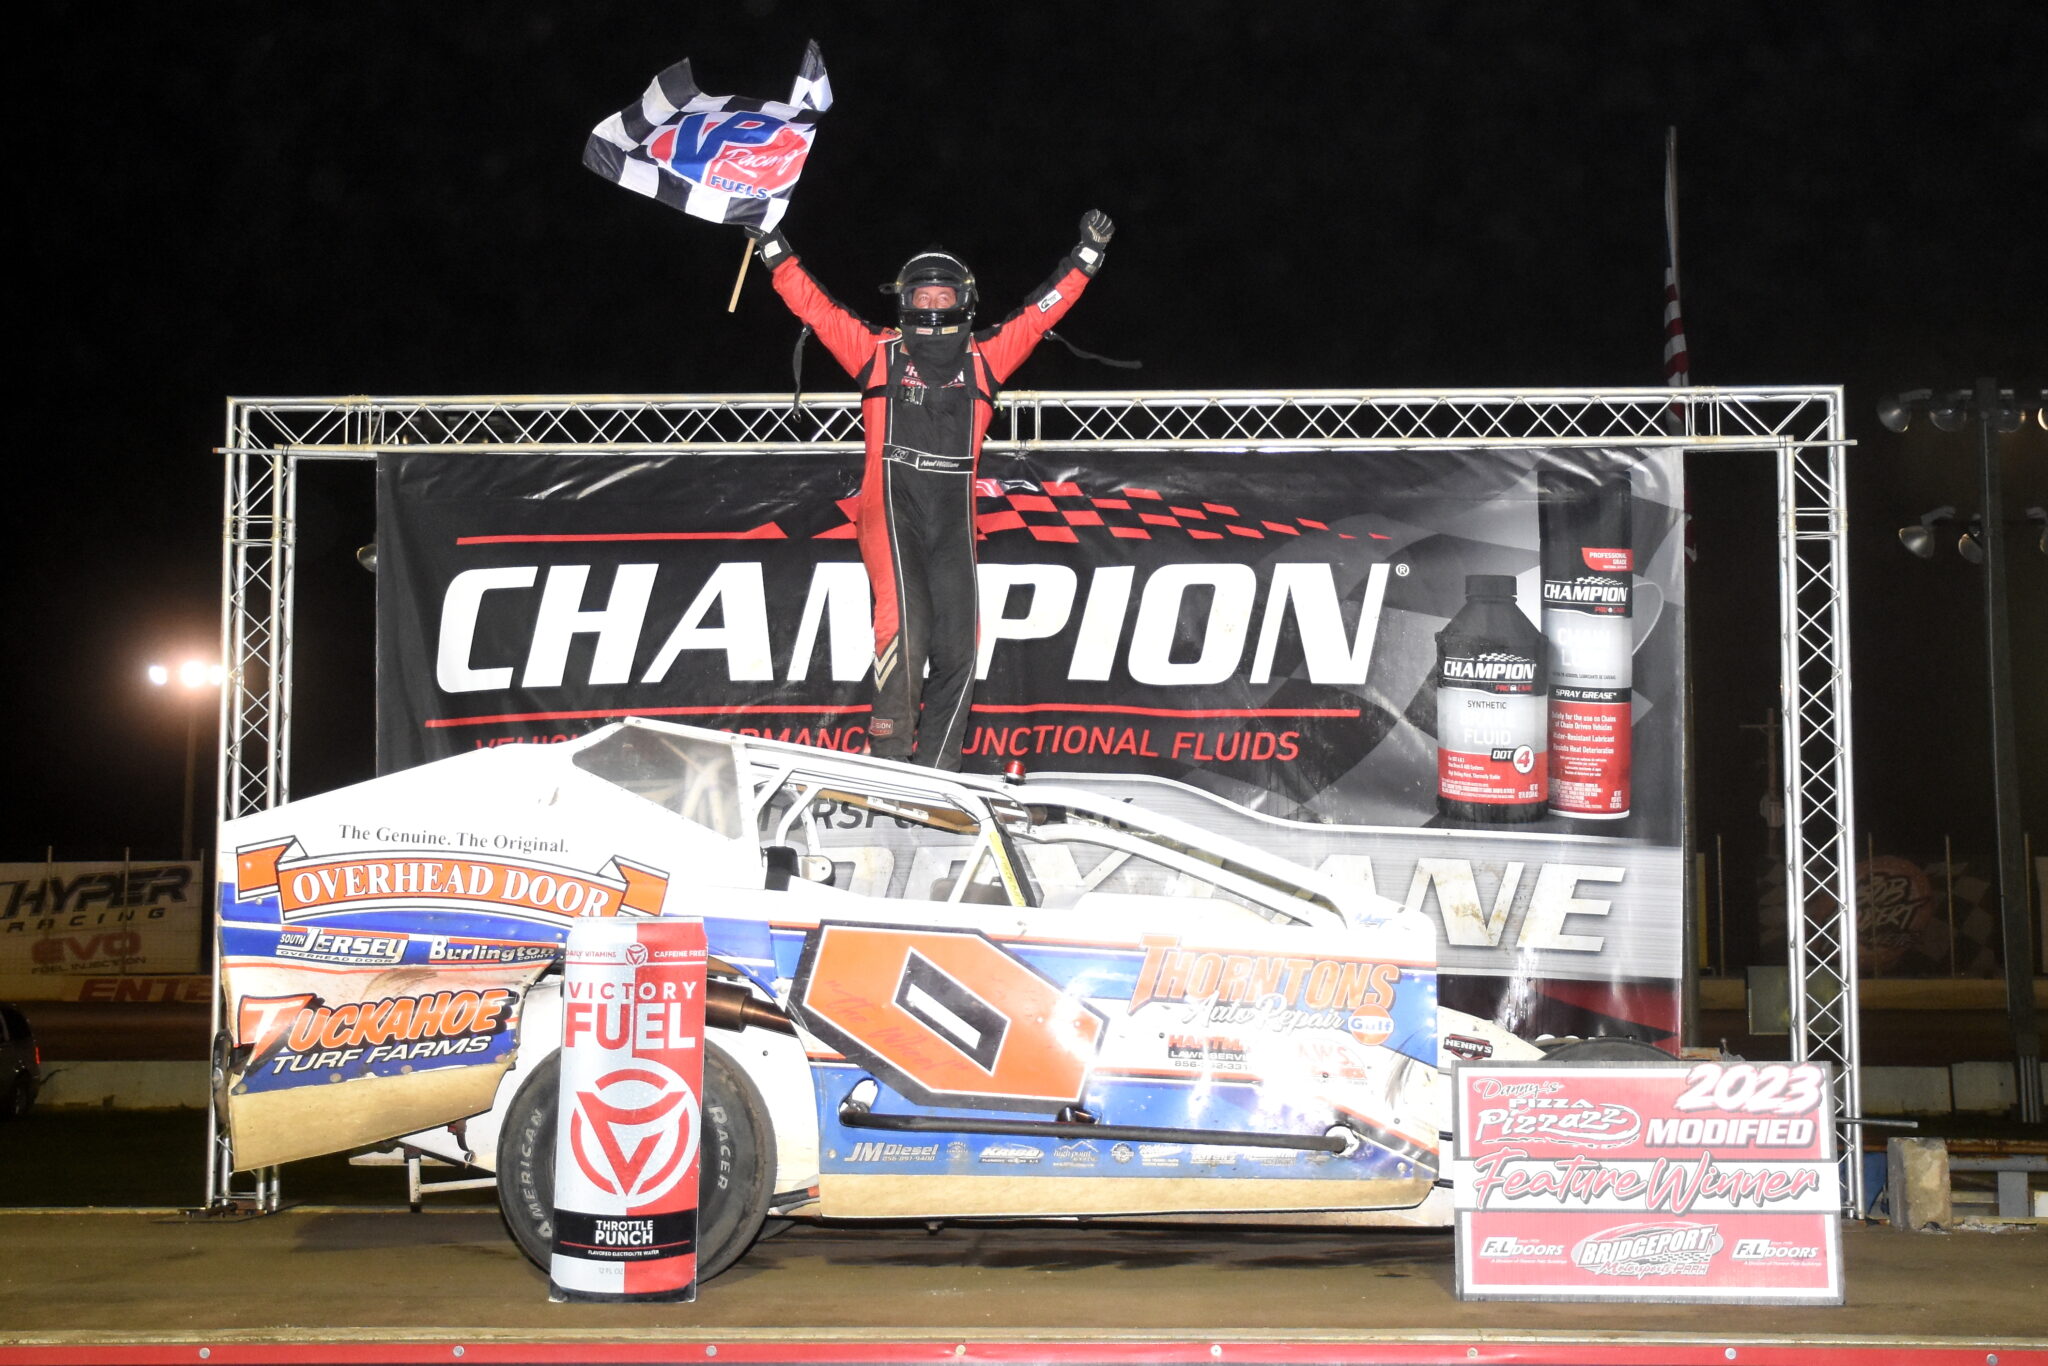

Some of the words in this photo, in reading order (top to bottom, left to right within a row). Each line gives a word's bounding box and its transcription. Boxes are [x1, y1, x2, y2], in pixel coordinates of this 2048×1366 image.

[715, 147, 807, 179] Racing
[711, 175, 769, 199] FUELS
[1543, 583, 1628, 602] CHAMPION
[1443, 660, 1535, 680] CHAMPION
[1467, 699, 1507, 710] SYNTHETIC
[1556, 688, 1581, 698] SPRAY
[1171, 730, 1301, 762] FLUIDS
[1492, 749, 1514, 760] DOT
[1515, 749, 1531, 768] 4
[340, 824, 371, 842] The
[376, 827, 452, 847] Genuine.
[457, 832, 488, 849] The
[494, 833, 570, 854] Original.
[0, 867, 192, 919] HYPER
[291, 862, 494, 904] OVERHEAD
[500, 868, 610, 917] DOOR
[7, 908, 166, 932] RACING
[280, 933, 306, 945] SOUTH
[297, 927, 409, 958] JERSEY
[430, 935, 555, 962] Burlington
[654, 950, 687, 958] CAFFEINE
[280, 950, 350, 963] OVERHEAD
[353, 956, 394, 965] DOOR
[1128, 935, 1400, 1014] THORNTONS
[568, 981, 697, 1000] VICTORY
[240, 989, 510, 1053] TUCKAHOE
[1183, 991, 1254, 1029] Auto
[1254, 995, 1345, 1033] Repair
[565, 1002, 696, 1051] FUEL
[273, 1048, 364, 1075] TURF
[366, 1035, 492, 1064] FARMS
[1473, 1077, 1564, 1100] Danny's
[1676, 1063, 1825, 1115] 2023
[1508, 1098, 1595, 1109] PIZZA
[1646, 1119, 1819, 1148] MODIFIED
[707, 1106, 731, 1190] RACER
[844, 1142, 885, 1162] JM
[883, 1143, 939, 1155] Diesel
[519, 1107, 553, 1239] AMERICAN
[1474, 1147, 1648, 1211] Feature
[1646, 1150, 1820, 1216] Winner
[595, 1219, 654, 1231] THROTTLE
[595, 1231, 653, 1245] PUNCH
[1512, 1244, 1565, 1256] DOORS
[1582, 1226, 1715, 1268] BRIDGEPORT
[1765, 1246, 1819, 1259] DOORS
[1600, 1256, 1672, 1279] Motorsports
